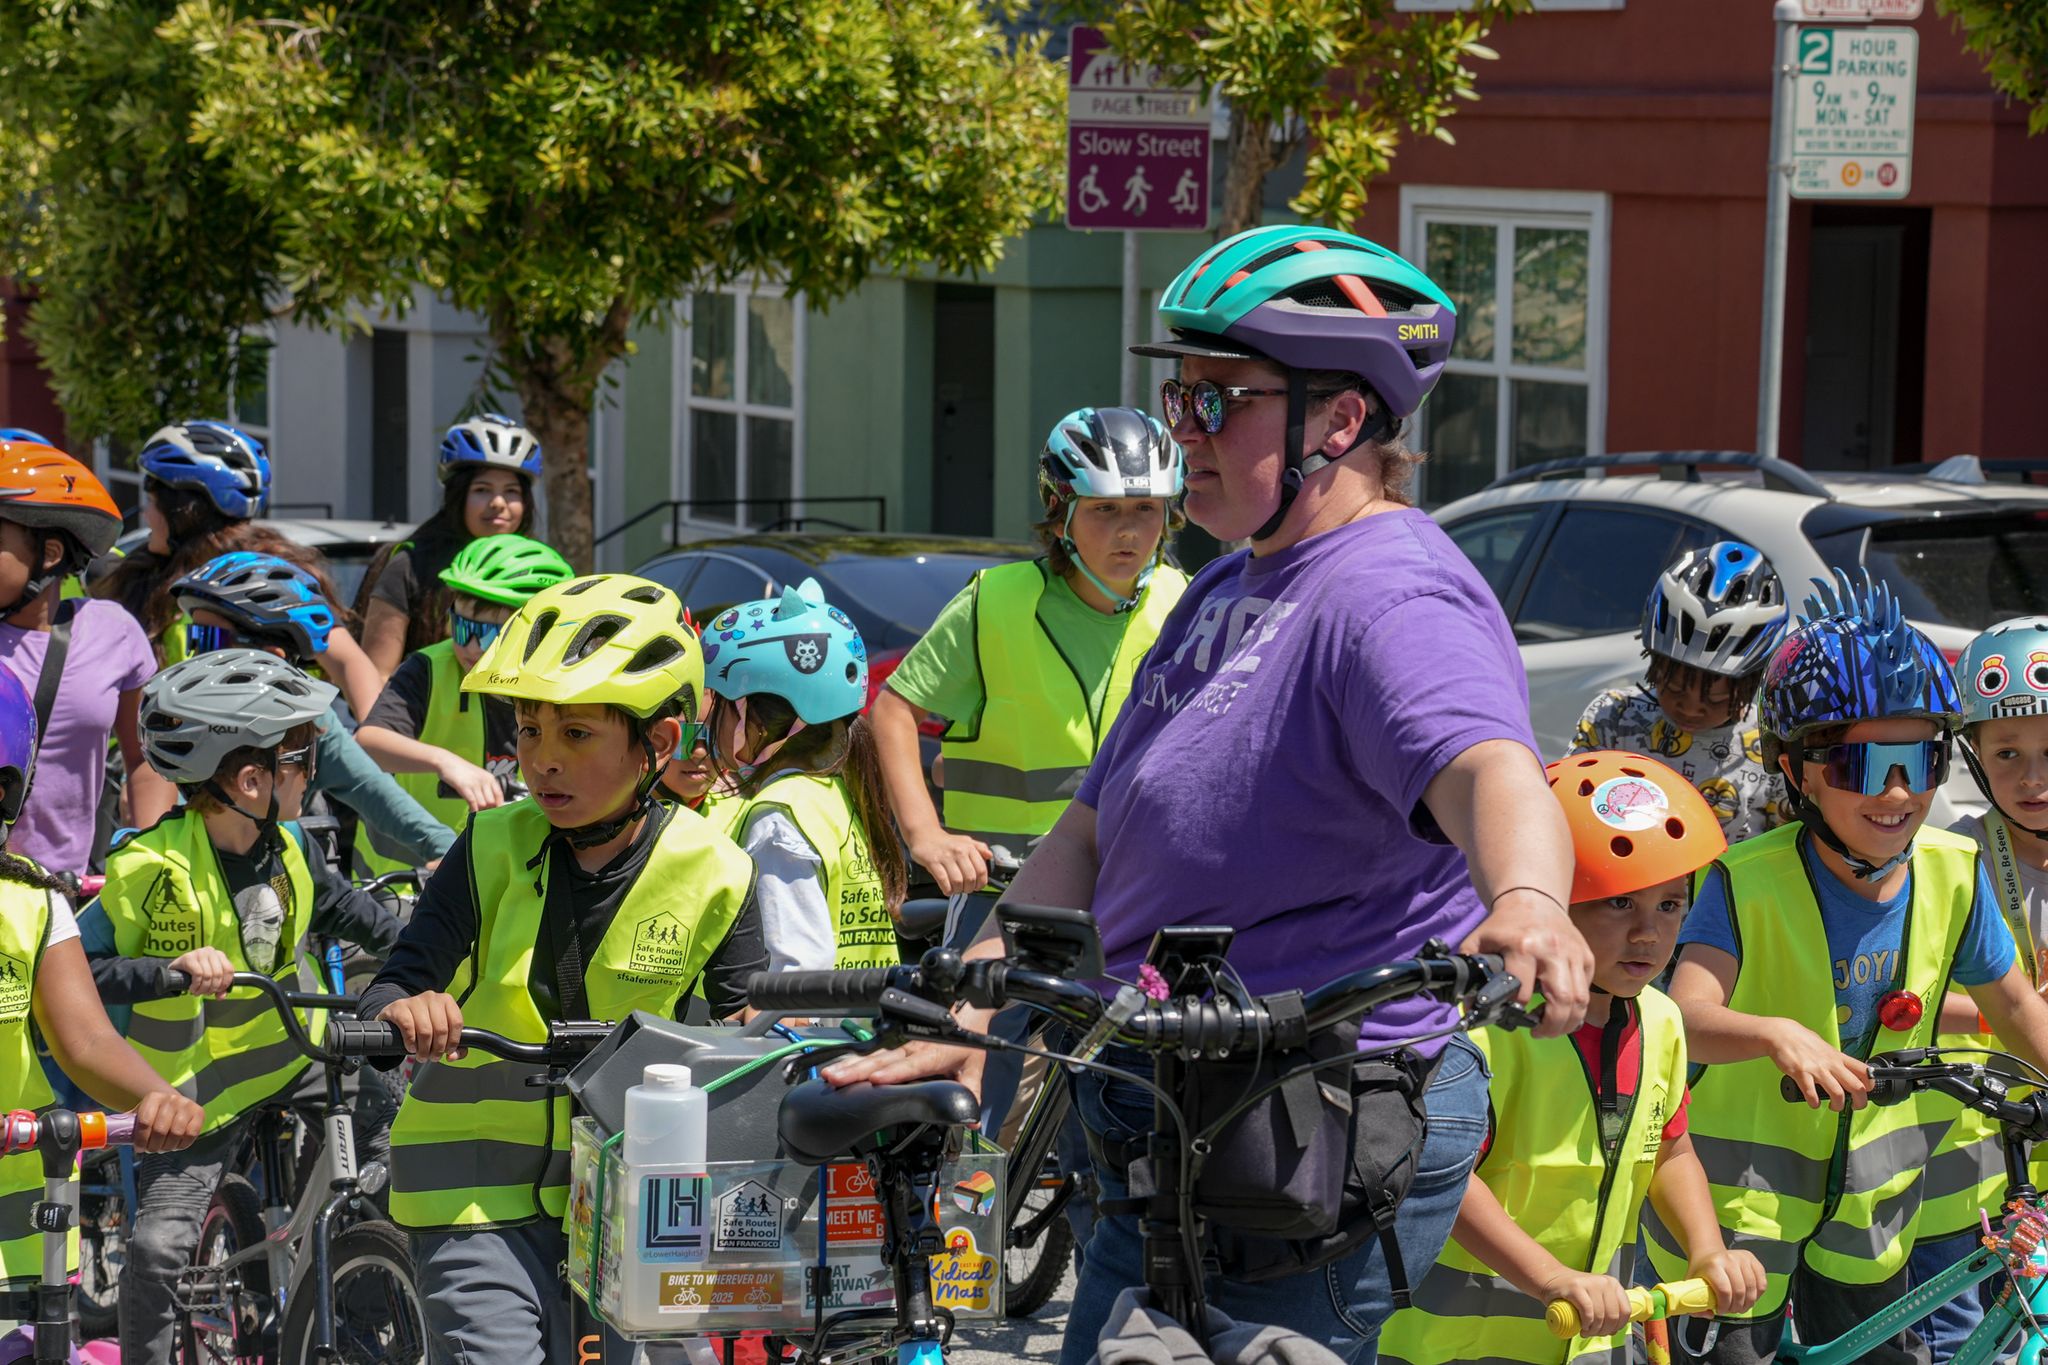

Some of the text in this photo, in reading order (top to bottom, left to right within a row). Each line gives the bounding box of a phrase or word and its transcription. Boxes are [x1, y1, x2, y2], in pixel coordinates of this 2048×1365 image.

[1804, 32, 1829, 71] 2
[1850, 38, 1897, 56] HOUR
[1837, 59, 1907, 77] PARKING
[1092, 97, 1132, 114] PAGE
[1816, 108, 1847, 125] MON
[1864, 108, 1889, 126] SAT
[1078, 131, 1202, 157] Slow Street
[1398, 323, 1439, 340] SMITH
[487, 672, 519, 685] Kevin
[1996, 826, 2020, 911] Be Safe. Be Seen.
[841, 888, 869, 905] Safe
[840, 906, 889, 926] to Sch
[150, 919, 196, 932] outes
[147, 934, 196, 952] hool
[839, 930, 896, 945] AN FRANC
[637, 943, 683, 956] Safe Routes
[636, 953, 682, 966] to School
[630, 963, 682, 976] SAN FRANCISCO
[0, 991, 28, 1004] chool
[337, 1118, 350, 1175] GIANT
[723, 1219, 777, 1228] Safe Routes
[826, 1210, 854, 1225] MEET
[857, 1209, 875, 1224] ME
[723, 1228, 776, 1238] to School
[737, 1240, 778, 1248] FRANCISCO
[805, 1264, 850, 1279] GAT
[929, 1259, 993, 1281] Kidical
[668, 1273, 775, 1286] BIKE TO WHEREVER DAY
[806, 1277, 872, 1292] HHWAY
[711, 1292, 734, 1303] 2025
